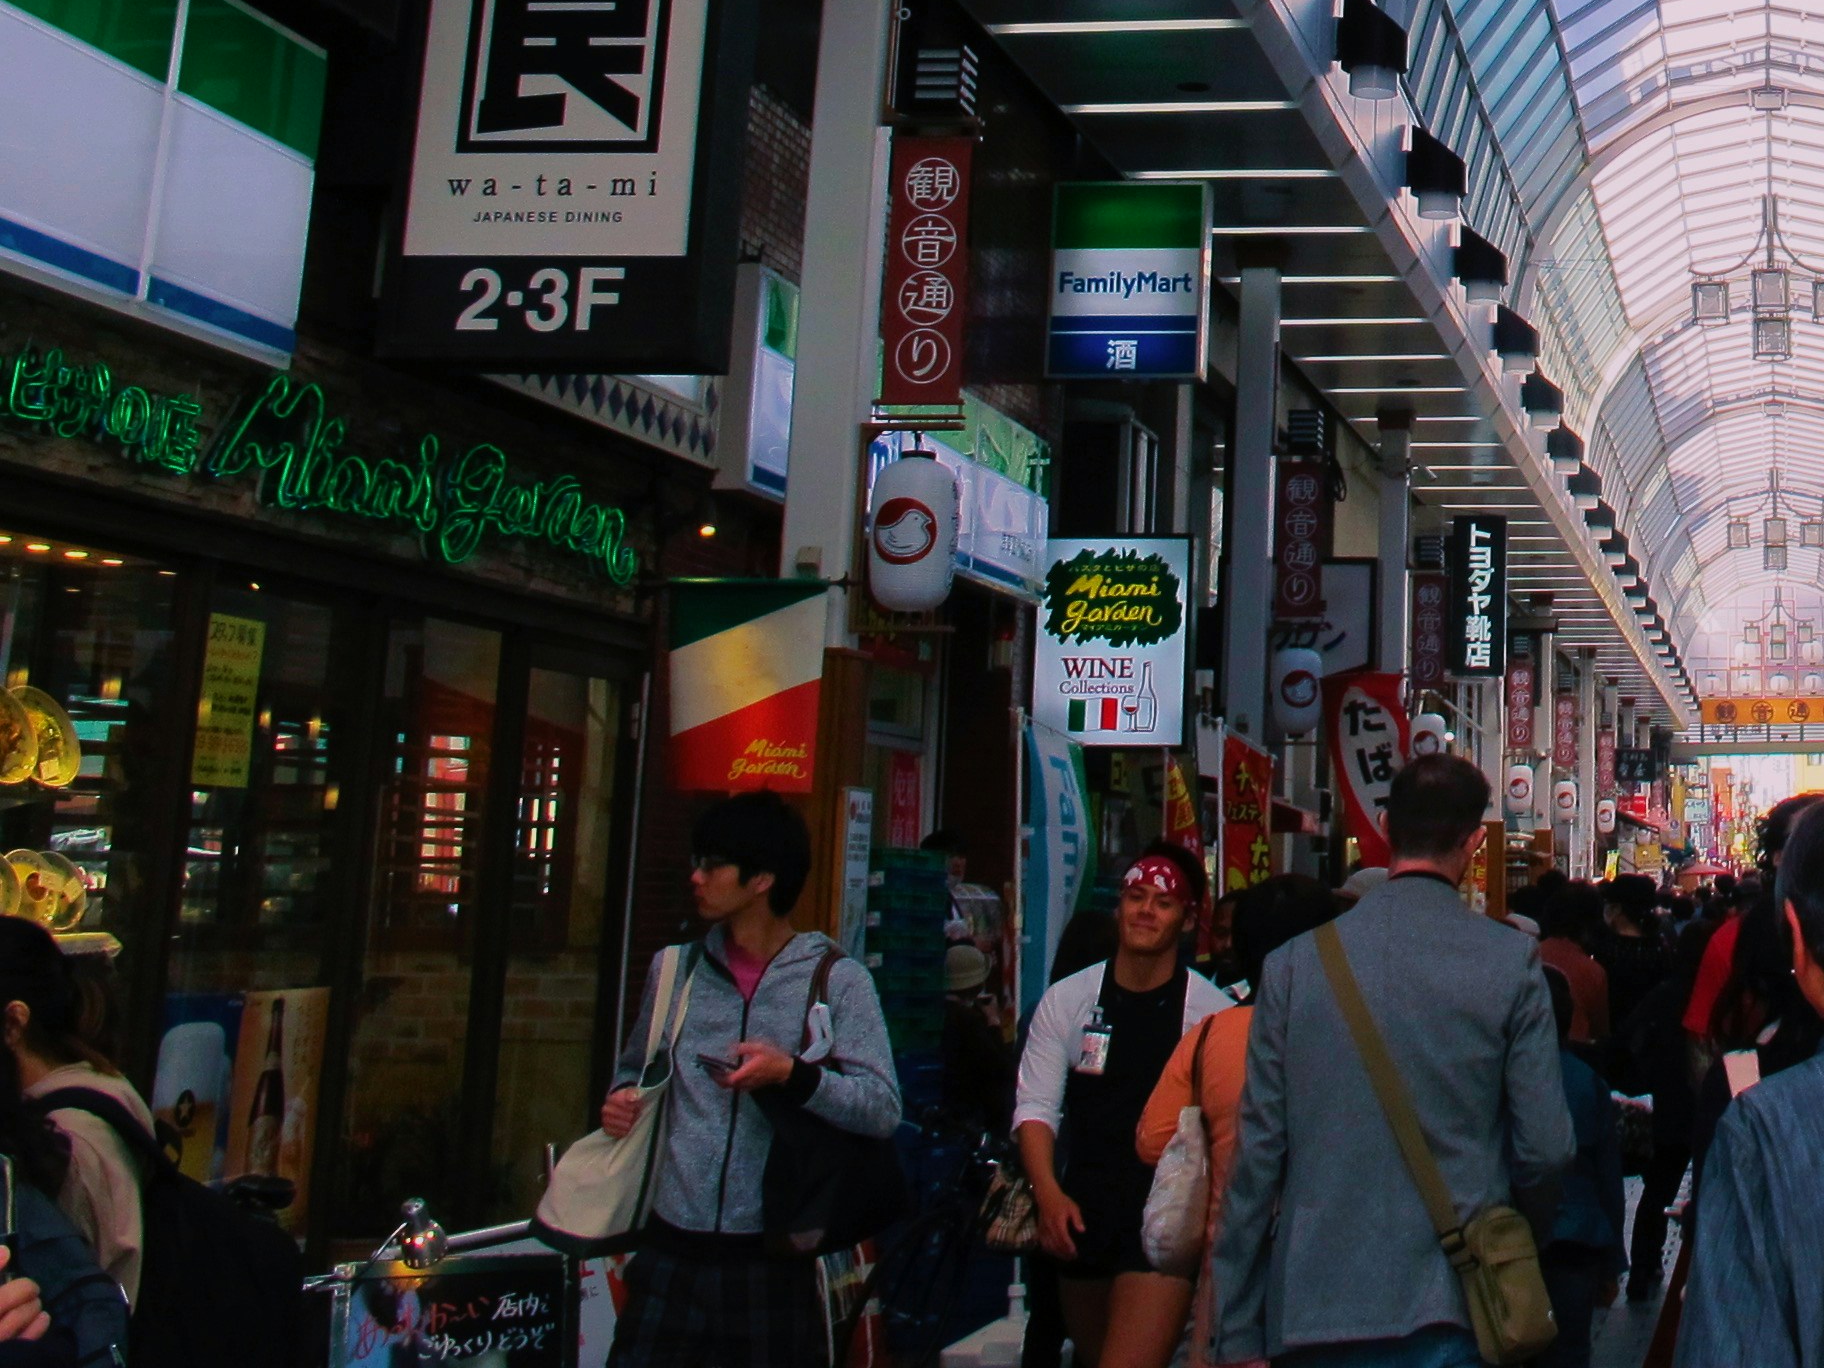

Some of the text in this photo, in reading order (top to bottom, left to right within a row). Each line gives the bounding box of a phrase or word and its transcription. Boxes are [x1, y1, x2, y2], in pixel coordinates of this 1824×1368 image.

[473, 211, 624, 224] JAPANESE DINING
[901, 161, 959, 378] 観音通り
[1058, 270, 1193, 296] FamilyMart
[1105, 338, 1139, 370] 酒
[209, 374, 440, 530] Miami
[1283, 475, 1317, 604] 観音通り
[1064, 574, 1162, 599] Miami
[1464, 522, 1494, 668] トヨダヤ靴店
[1415, 584, 1441, 679] 観音通り
[1061, 657, 1134, 679] WINE
[1059, 681, 1134, 695] Collections
[1511, 670, 1530, 742] 観音通り
[743, 739, 808, 759] Miami
